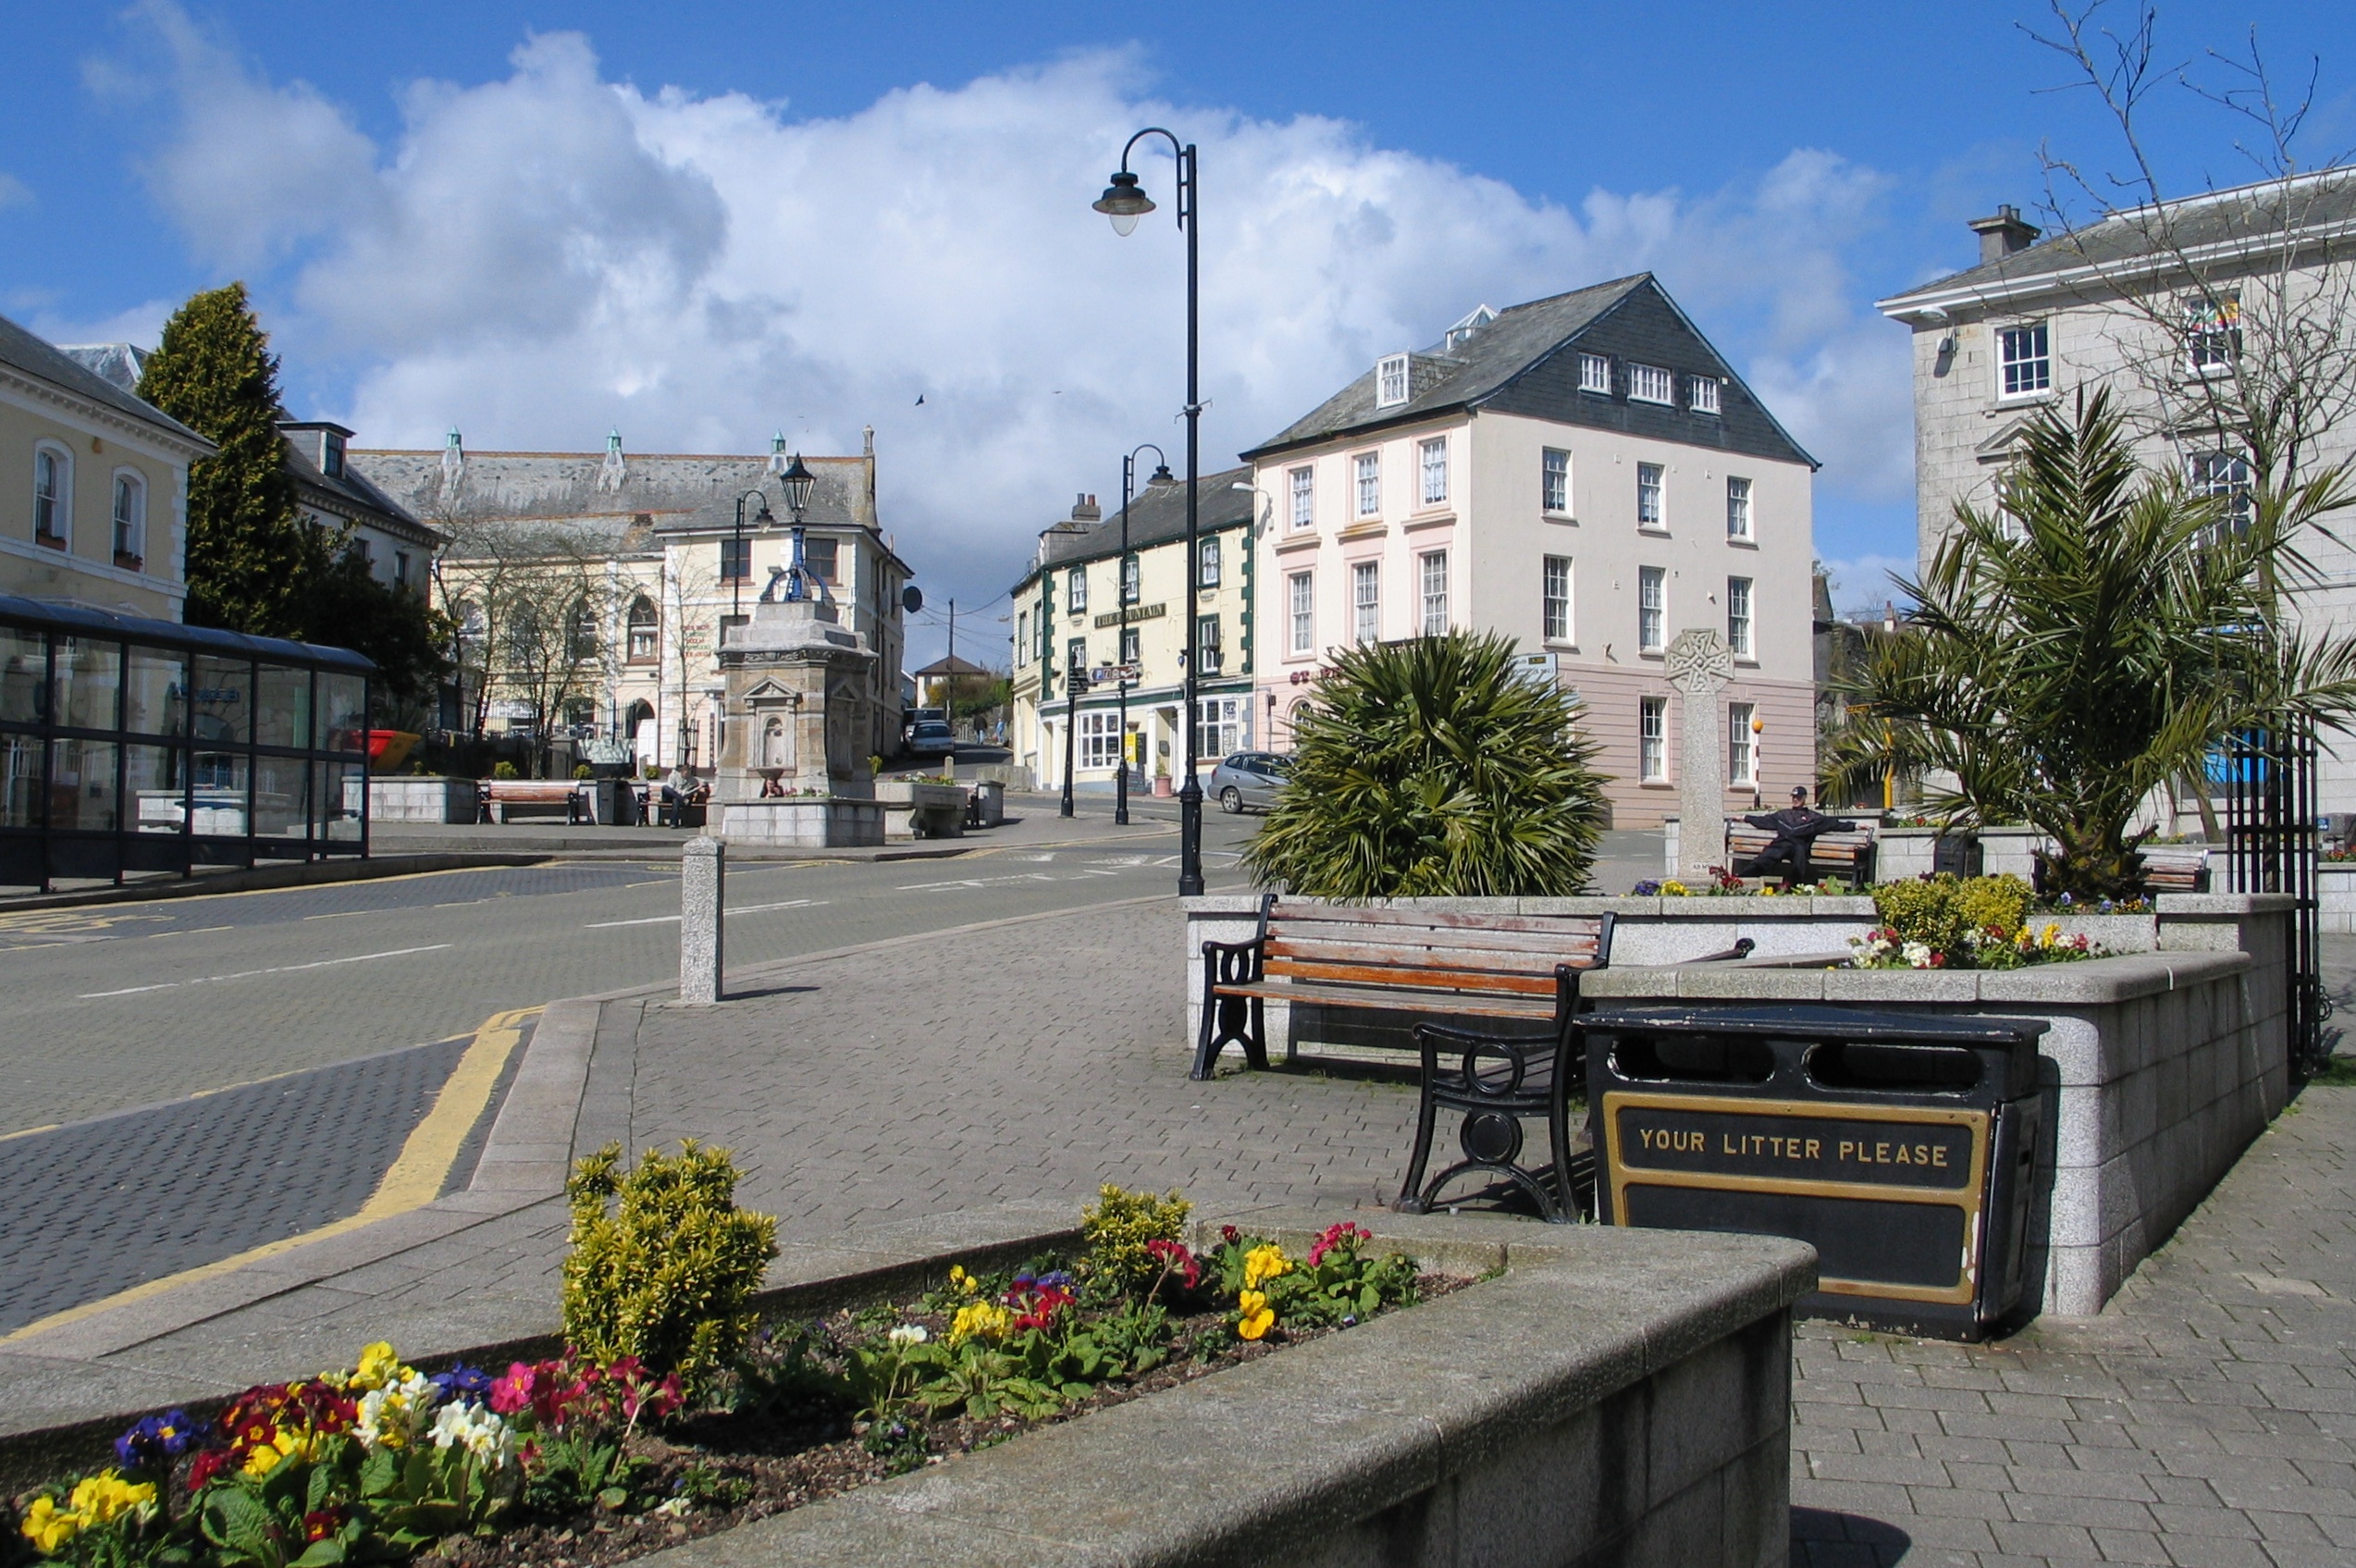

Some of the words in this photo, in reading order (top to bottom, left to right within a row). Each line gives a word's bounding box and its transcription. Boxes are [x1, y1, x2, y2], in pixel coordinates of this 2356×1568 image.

[1097, 615, 1114, 627] THE
[1640, 1129, 1705, 1152] YOUR
[1723, 1134, 1819, 1158] LITTER
[1839, 1142, 1947, 1167] PLEASE
